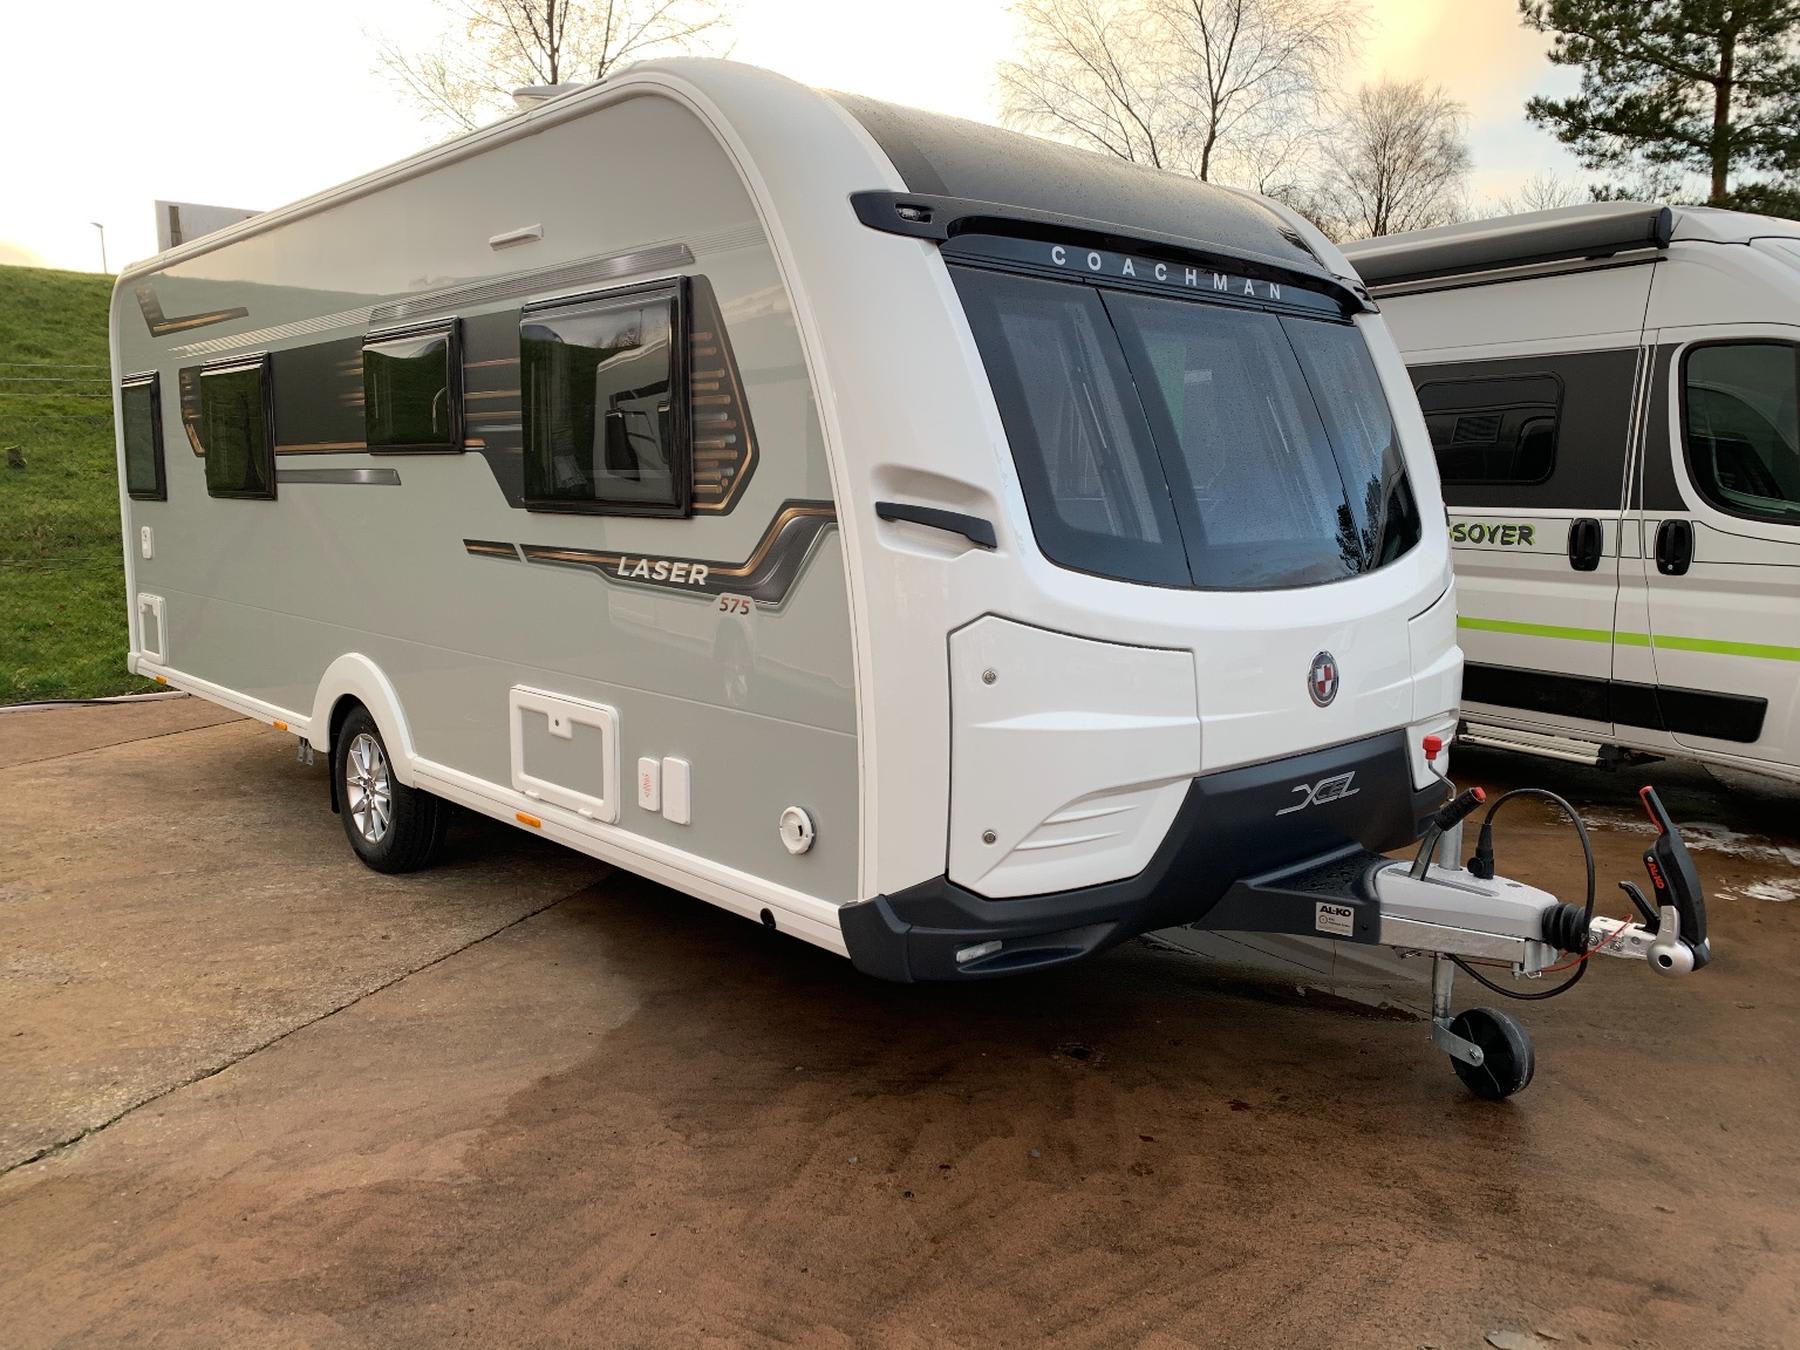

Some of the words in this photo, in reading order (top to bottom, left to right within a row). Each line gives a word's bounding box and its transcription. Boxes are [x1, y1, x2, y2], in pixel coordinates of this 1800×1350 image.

[1051, 245, 1281, 300] COACHMAN
[617, 556, 709, 586] LASER
[718, 597, 750, 615] 575
